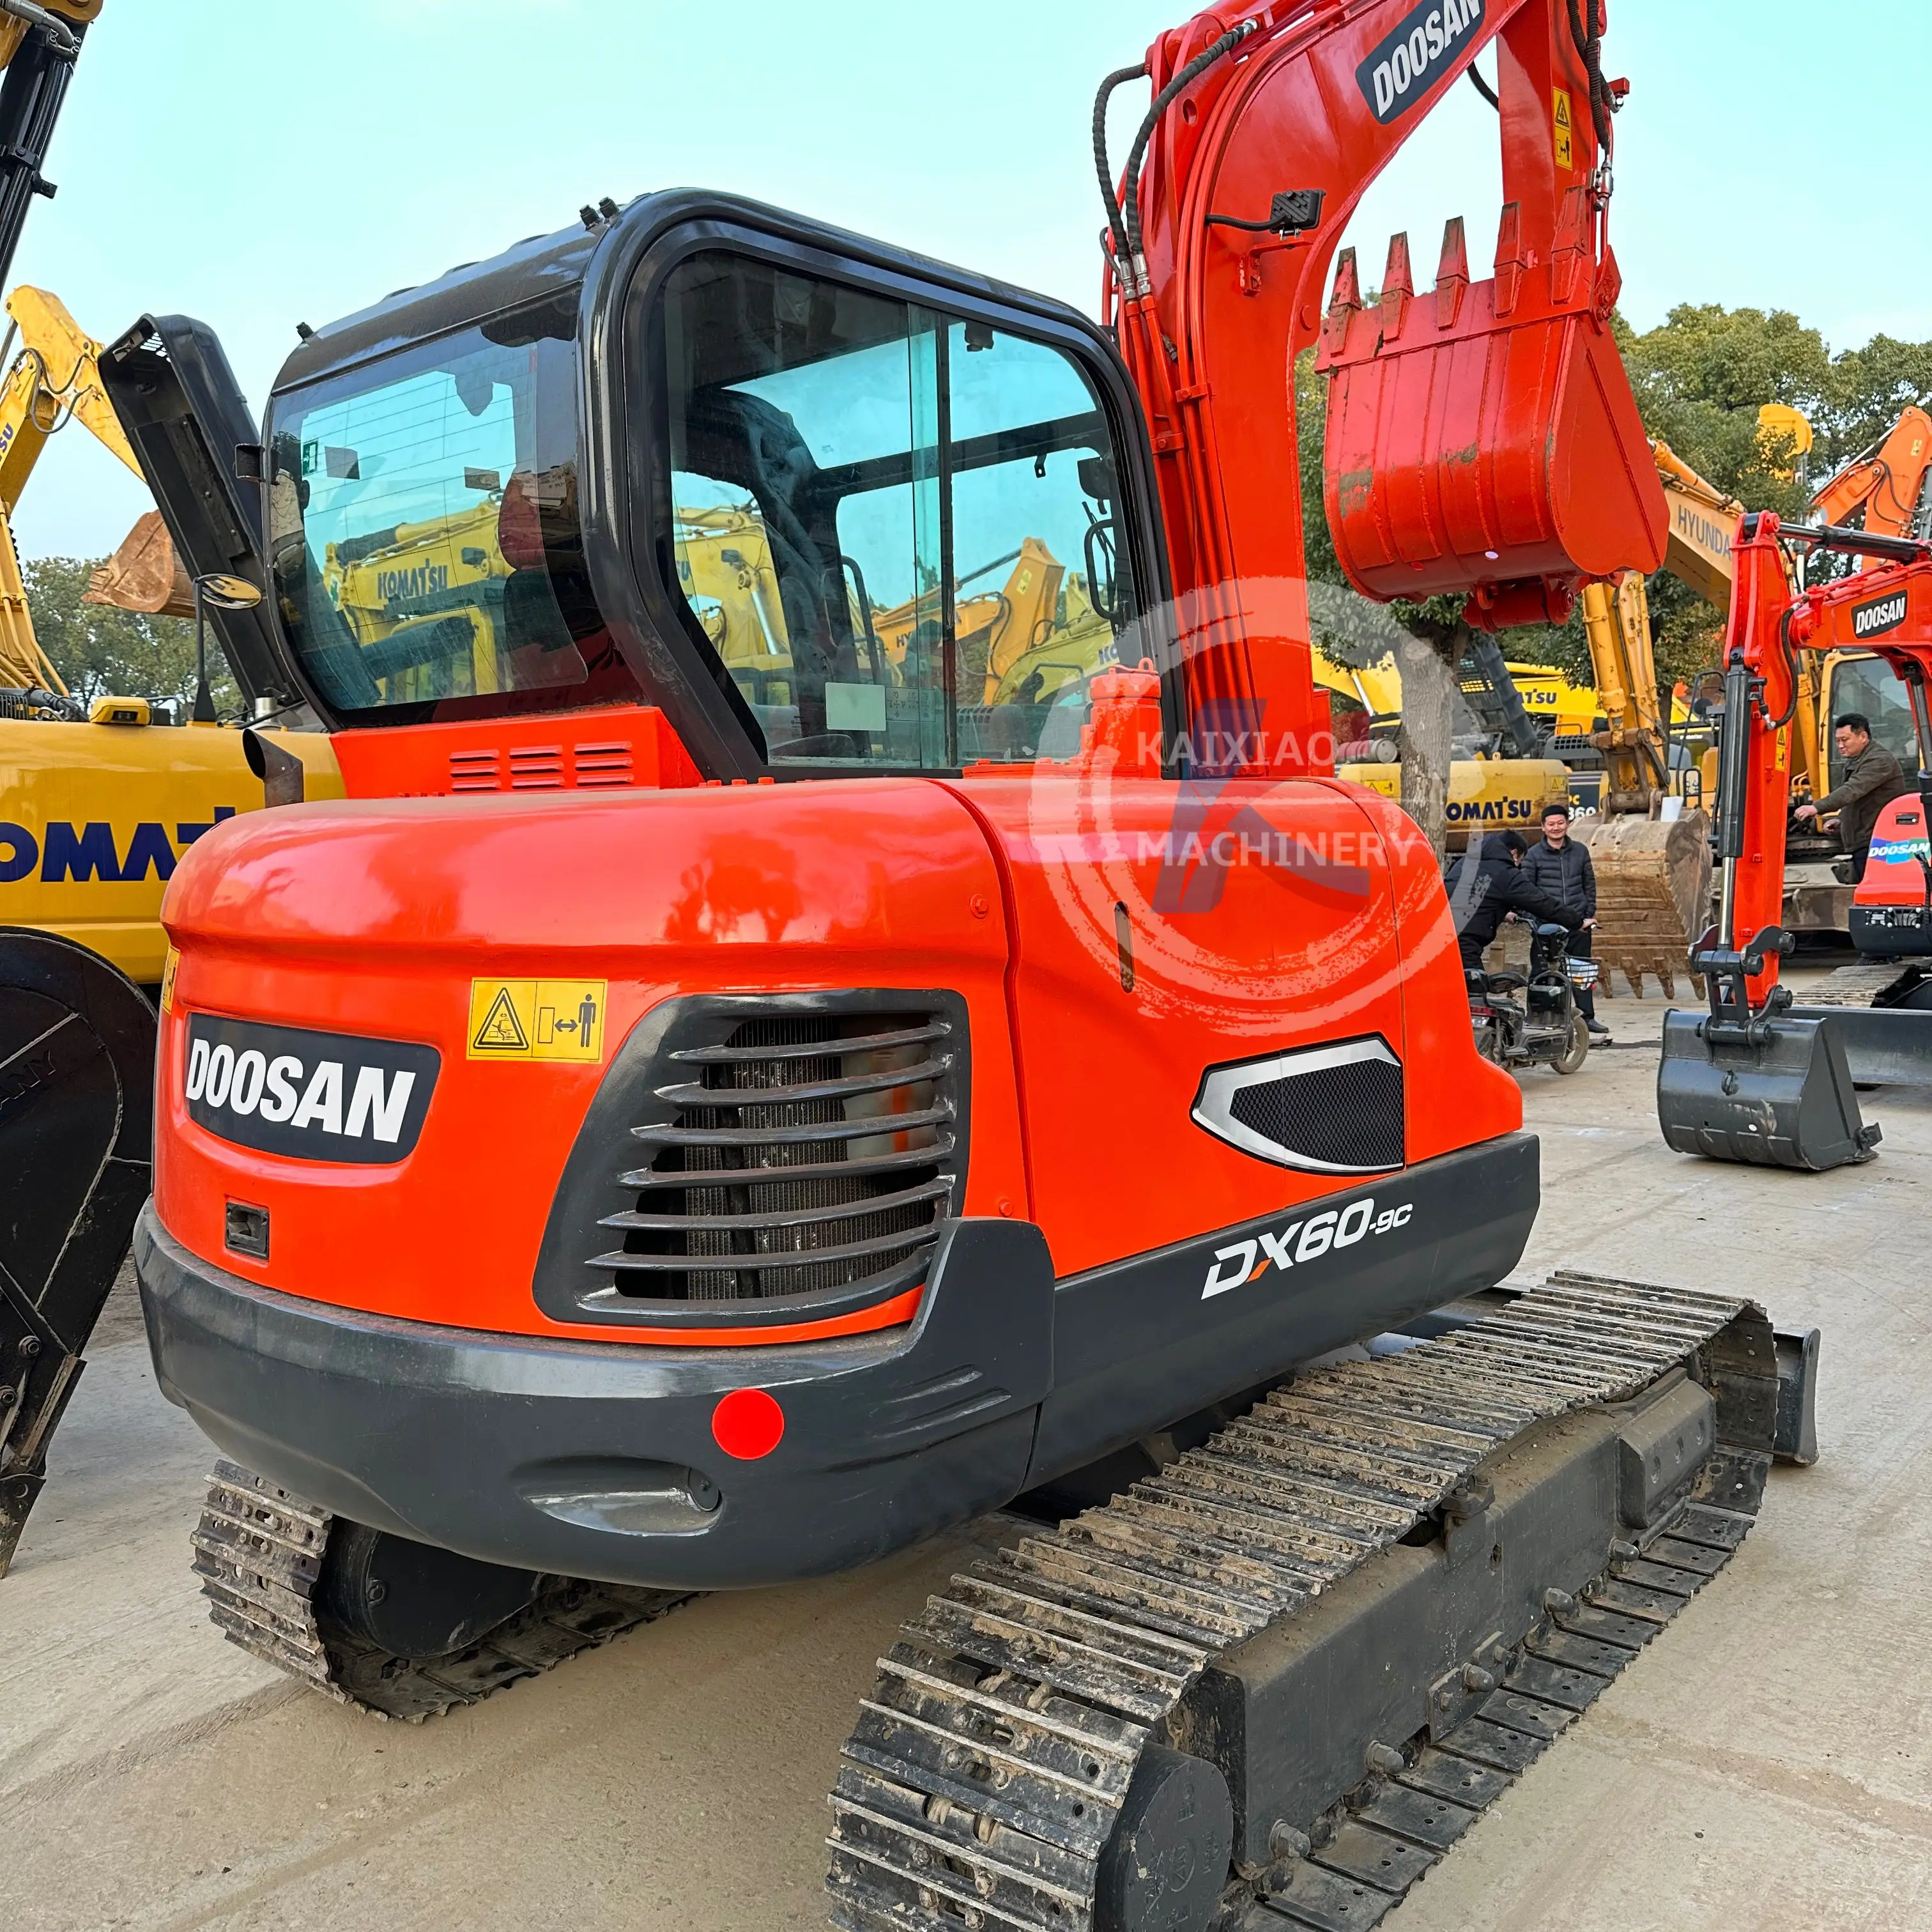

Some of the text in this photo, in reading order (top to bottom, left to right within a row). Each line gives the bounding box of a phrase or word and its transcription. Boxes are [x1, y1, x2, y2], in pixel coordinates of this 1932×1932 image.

[377, 558, 447, 599] KOMATSU
[1856, 597, 1905, 634] DOOSAN
[1446, 796, 1531, 821] OMATSU
[1868, 843, 1930, 857] DOOSAN
[186, 1038, 416, 1143] DOOSAN
[1200, 1198, 1413, 1300] DX60-9C
